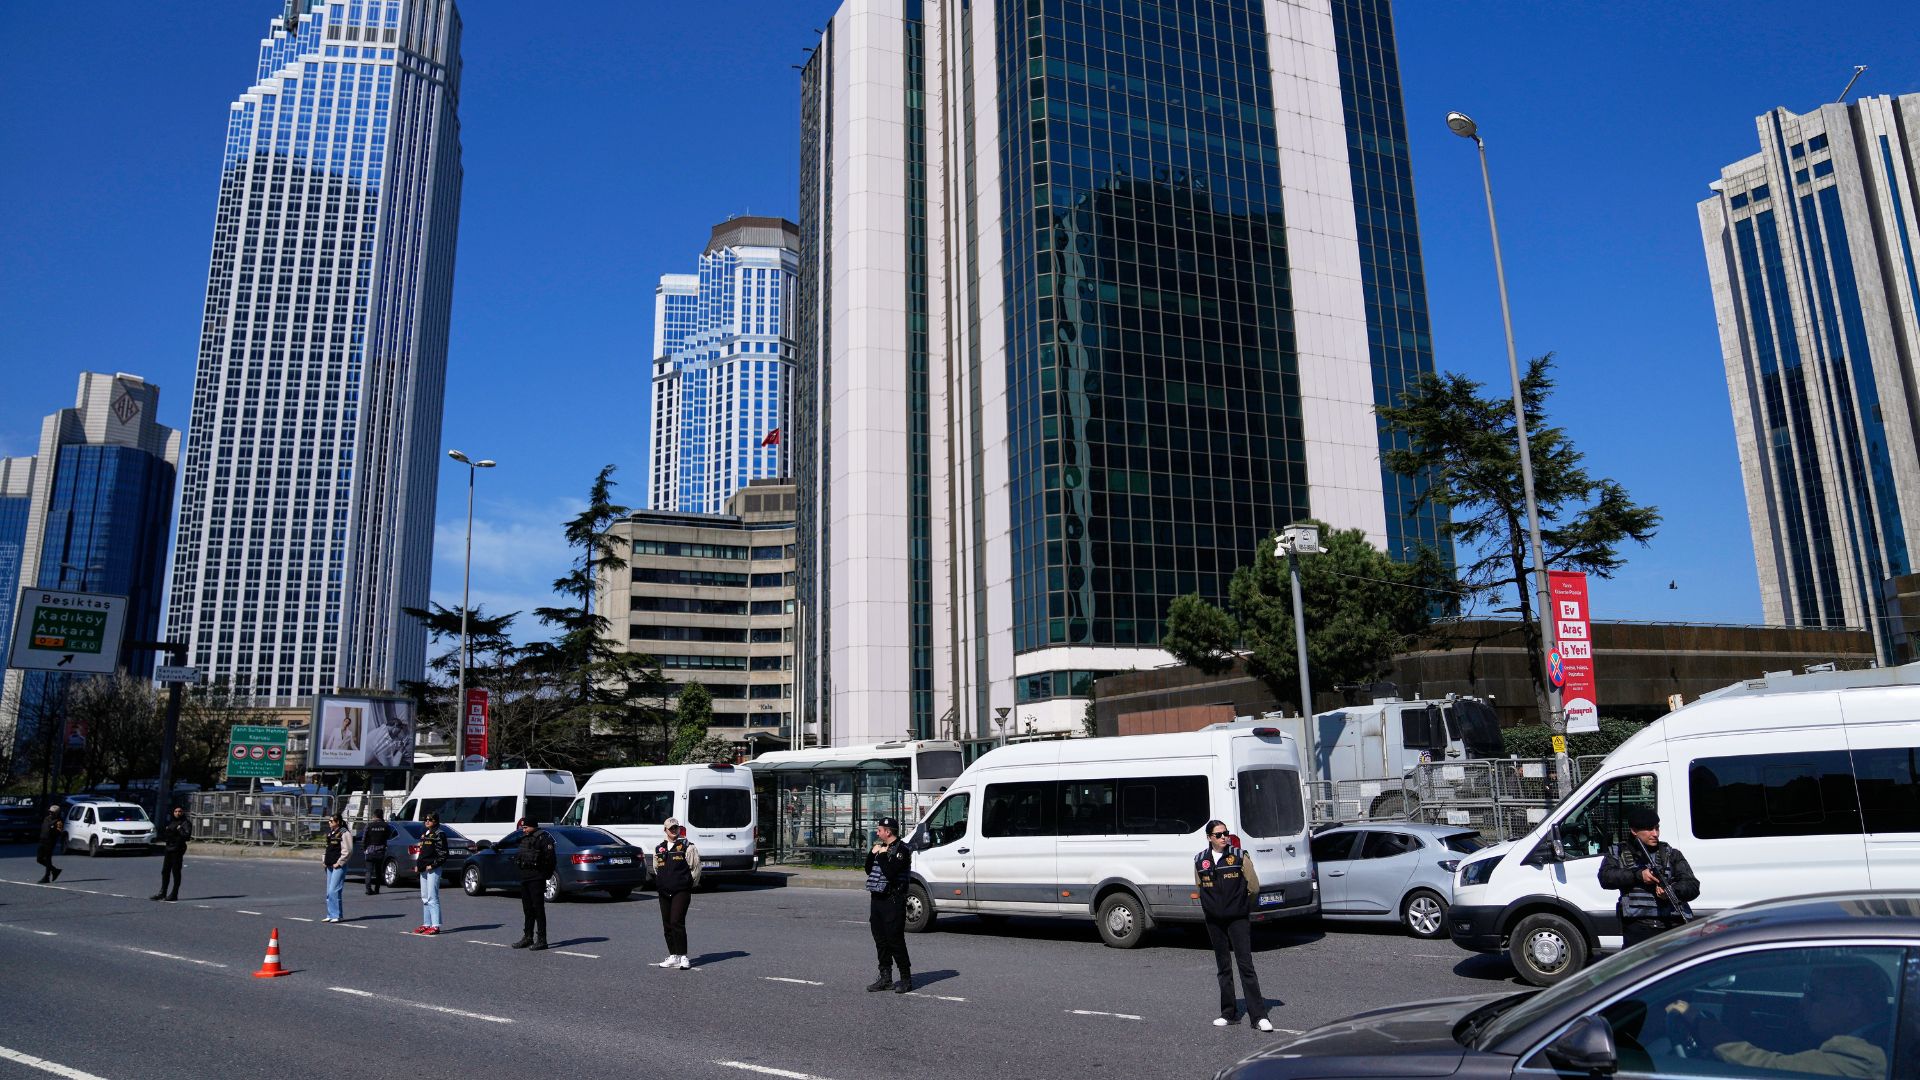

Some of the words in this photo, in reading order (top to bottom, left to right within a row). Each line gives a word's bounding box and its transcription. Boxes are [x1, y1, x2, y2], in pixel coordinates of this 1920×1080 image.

[42, 594, 111, 610] Beşiktaş
[1564, 605, 1575, 615] Ev
[38, 609, 103, 626] Kadıköy
[36, 623, 95, 637] Ankara
[1562, 624, 1582, 636] Araç
[1561, 642, 1569, 657] İş
[1570, 645, 1587, 656] Yeri
